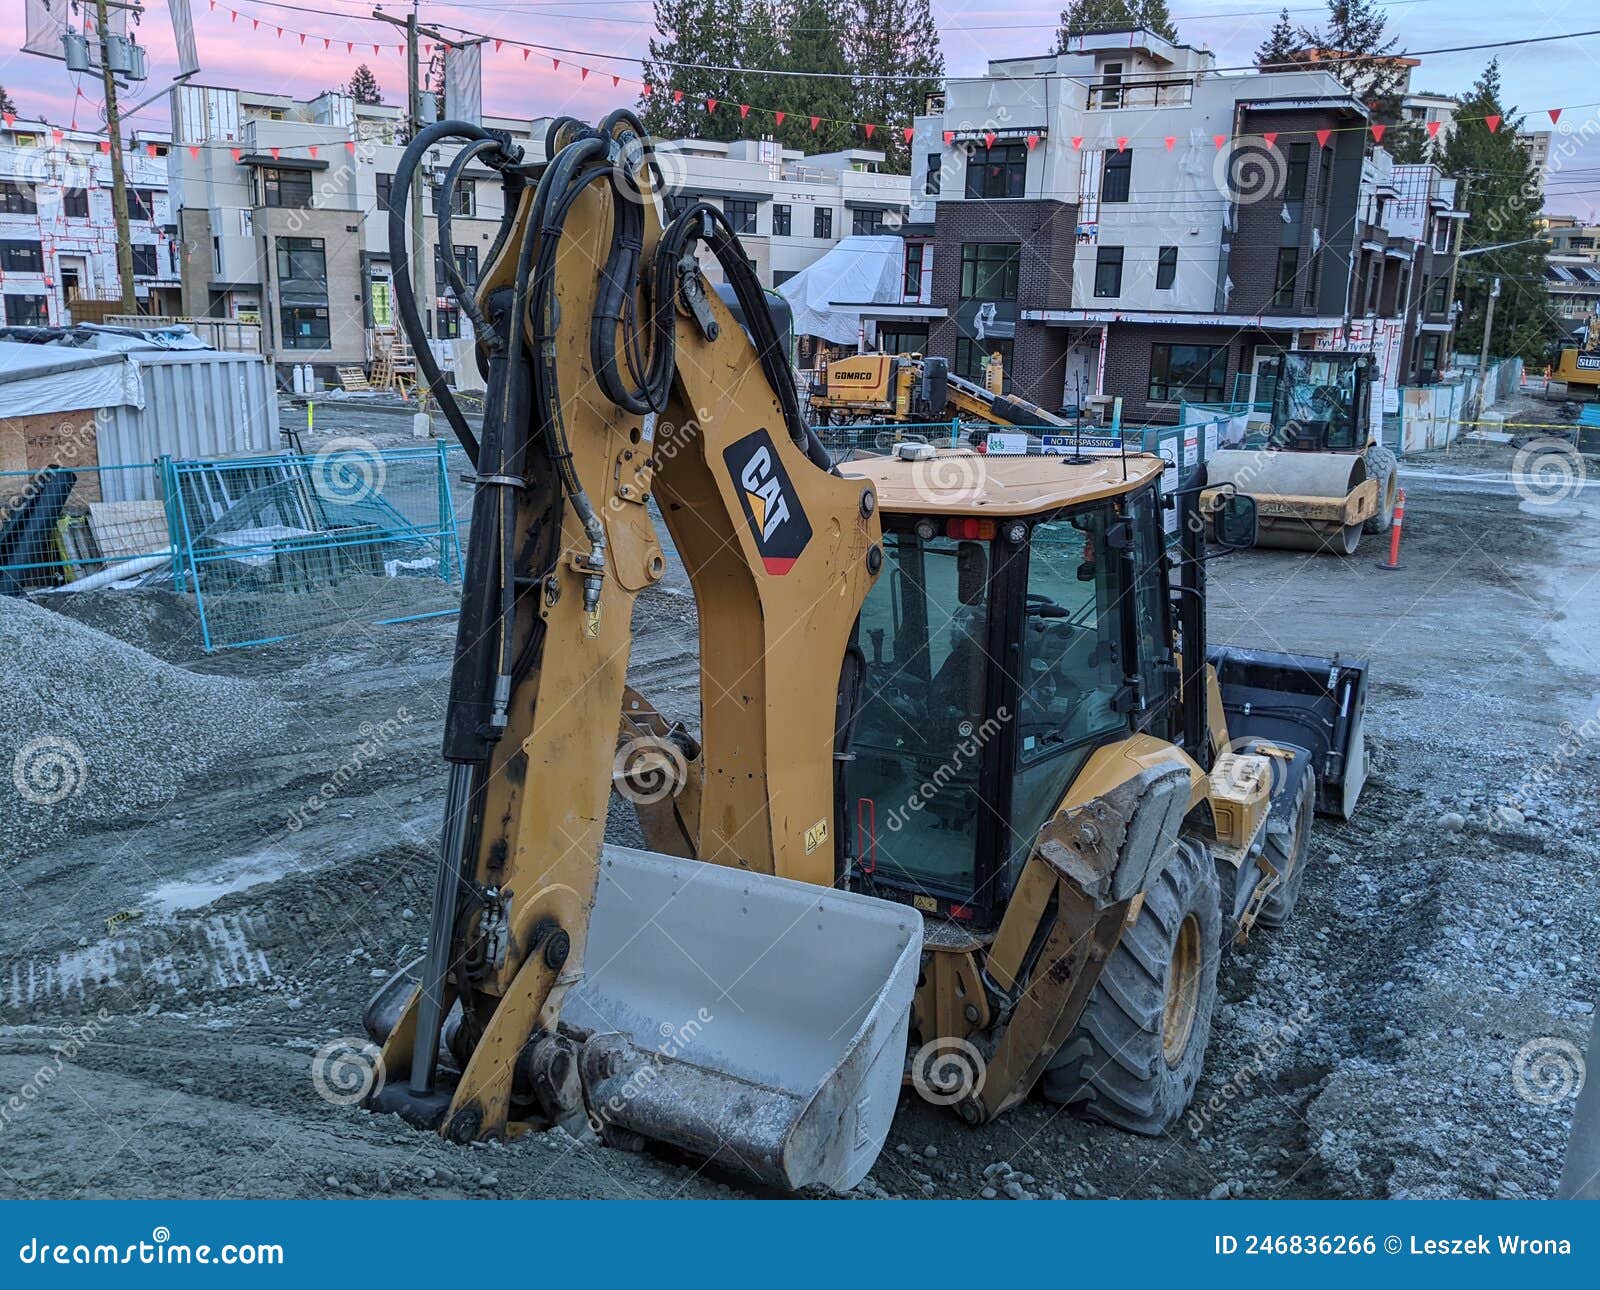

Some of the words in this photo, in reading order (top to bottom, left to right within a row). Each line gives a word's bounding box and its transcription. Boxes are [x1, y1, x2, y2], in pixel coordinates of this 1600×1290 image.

[834, 371, 872, 380] GOMACO
[1050, 437, 1064, 446] NO
[1065, 438, 1114, 448] TRESPASSING
[741, 445, 791, 544] CAT
